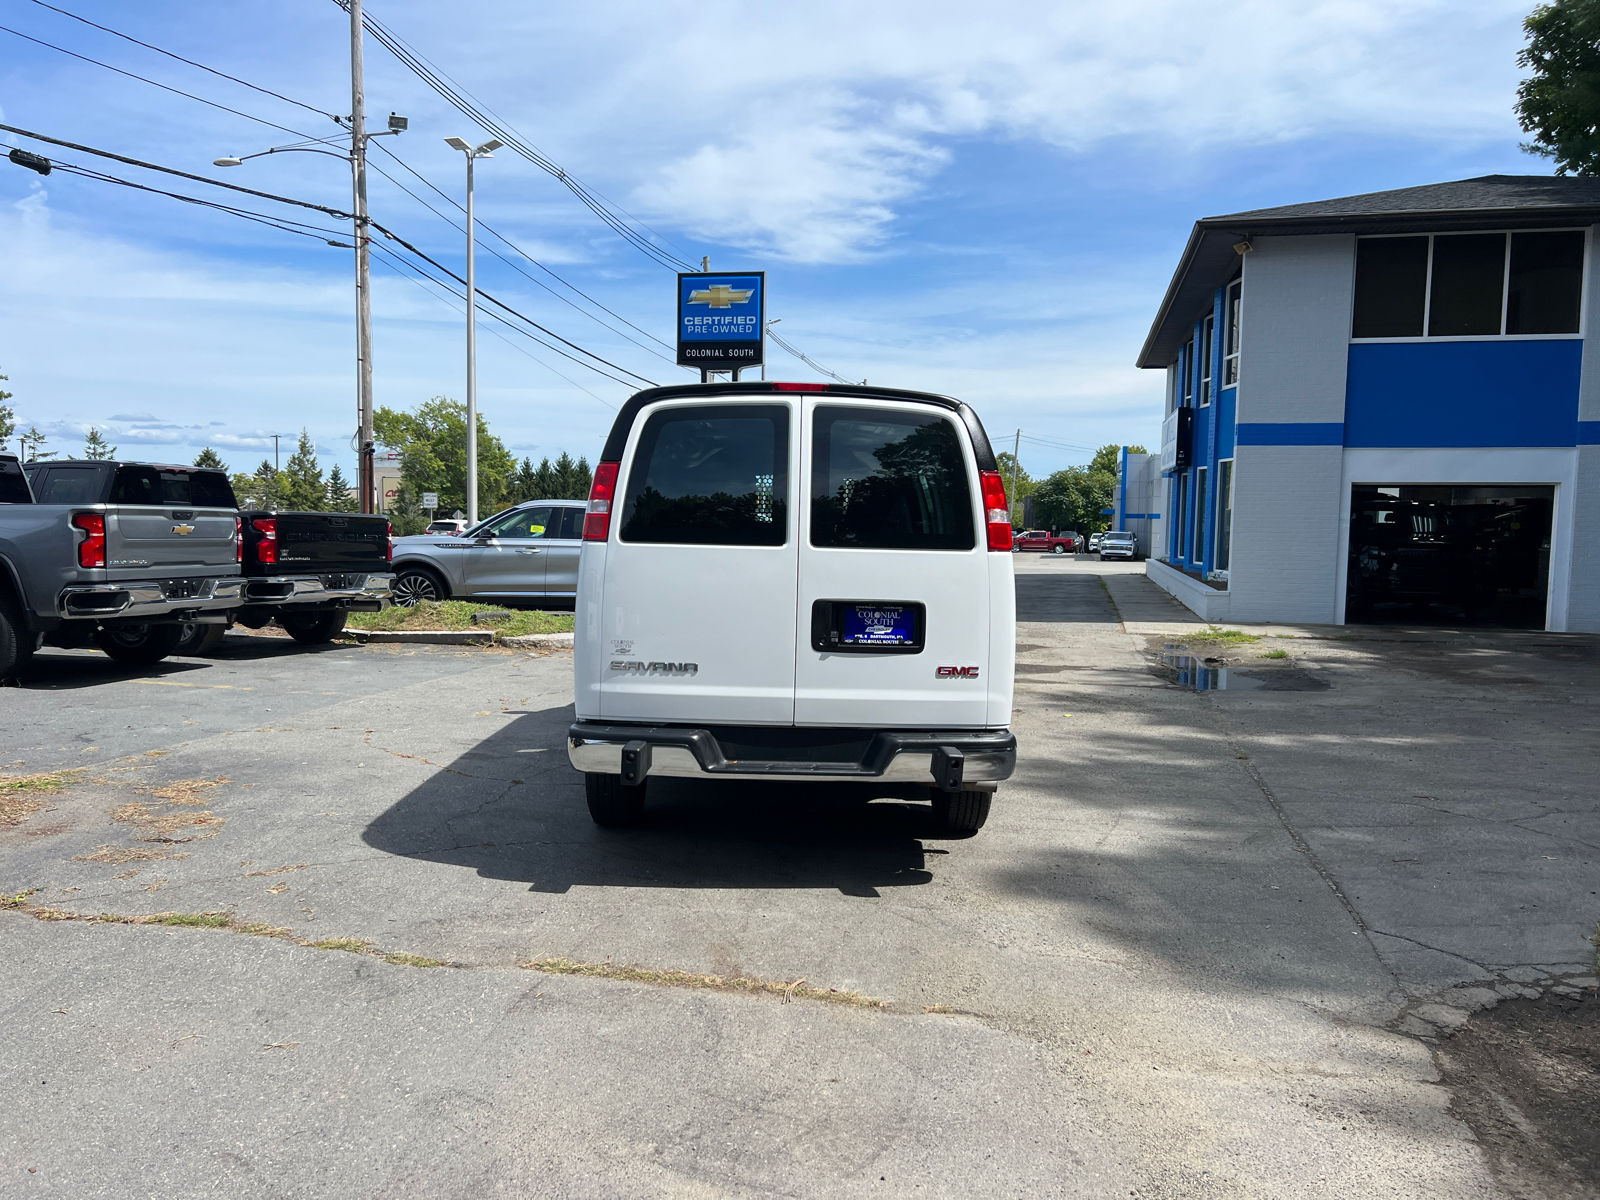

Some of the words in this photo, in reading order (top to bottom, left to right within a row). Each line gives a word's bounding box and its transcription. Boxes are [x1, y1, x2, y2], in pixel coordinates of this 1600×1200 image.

[684, 316, 756, 325] CERTIFIED
[687, 325, 753, 333] PRE-OWNED
[686, 349, 724, 357] COLONIAL
[728, 349, 754, 357] SOUTH
[286, 533, 382, 542] CHEVROLET
[610, 660, 699, 672] SAVANA
[937, 666, 979, 676] GMC
